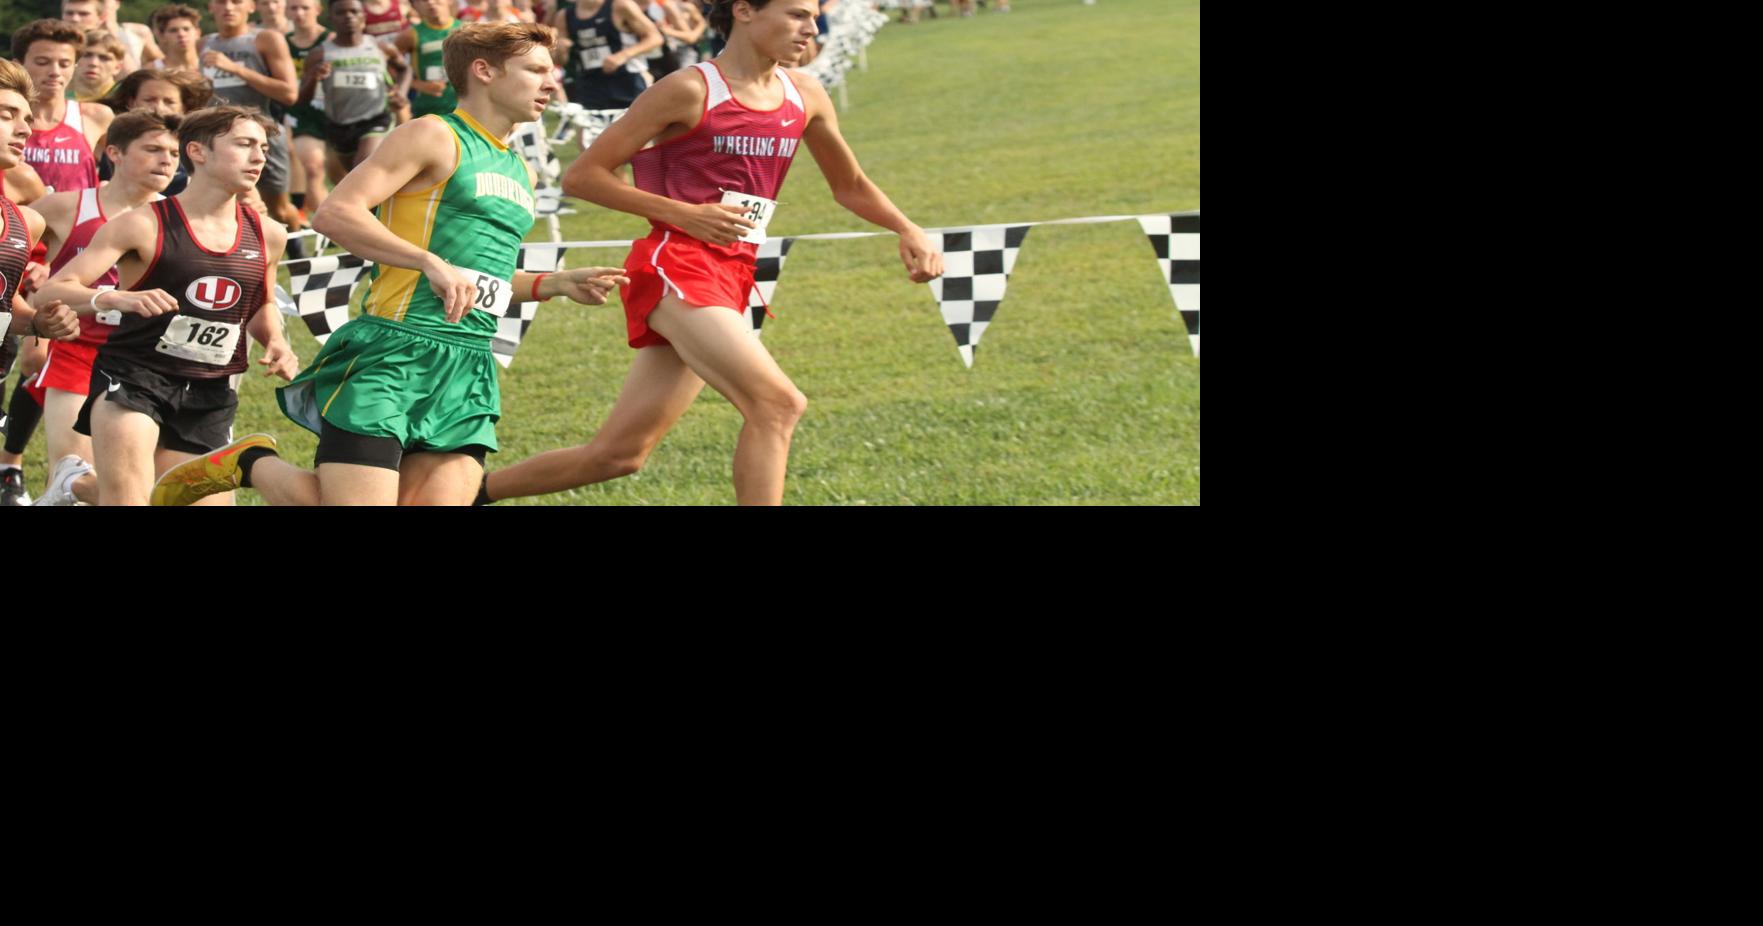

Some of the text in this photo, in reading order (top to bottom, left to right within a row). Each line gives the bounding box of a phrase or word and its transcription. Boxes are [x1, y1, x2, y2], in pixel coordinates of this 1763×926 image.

[54, 148, 80, 164] PARK
[713, 136, 775, 156] WHEELING
[187, 322, 230, 348] 162
